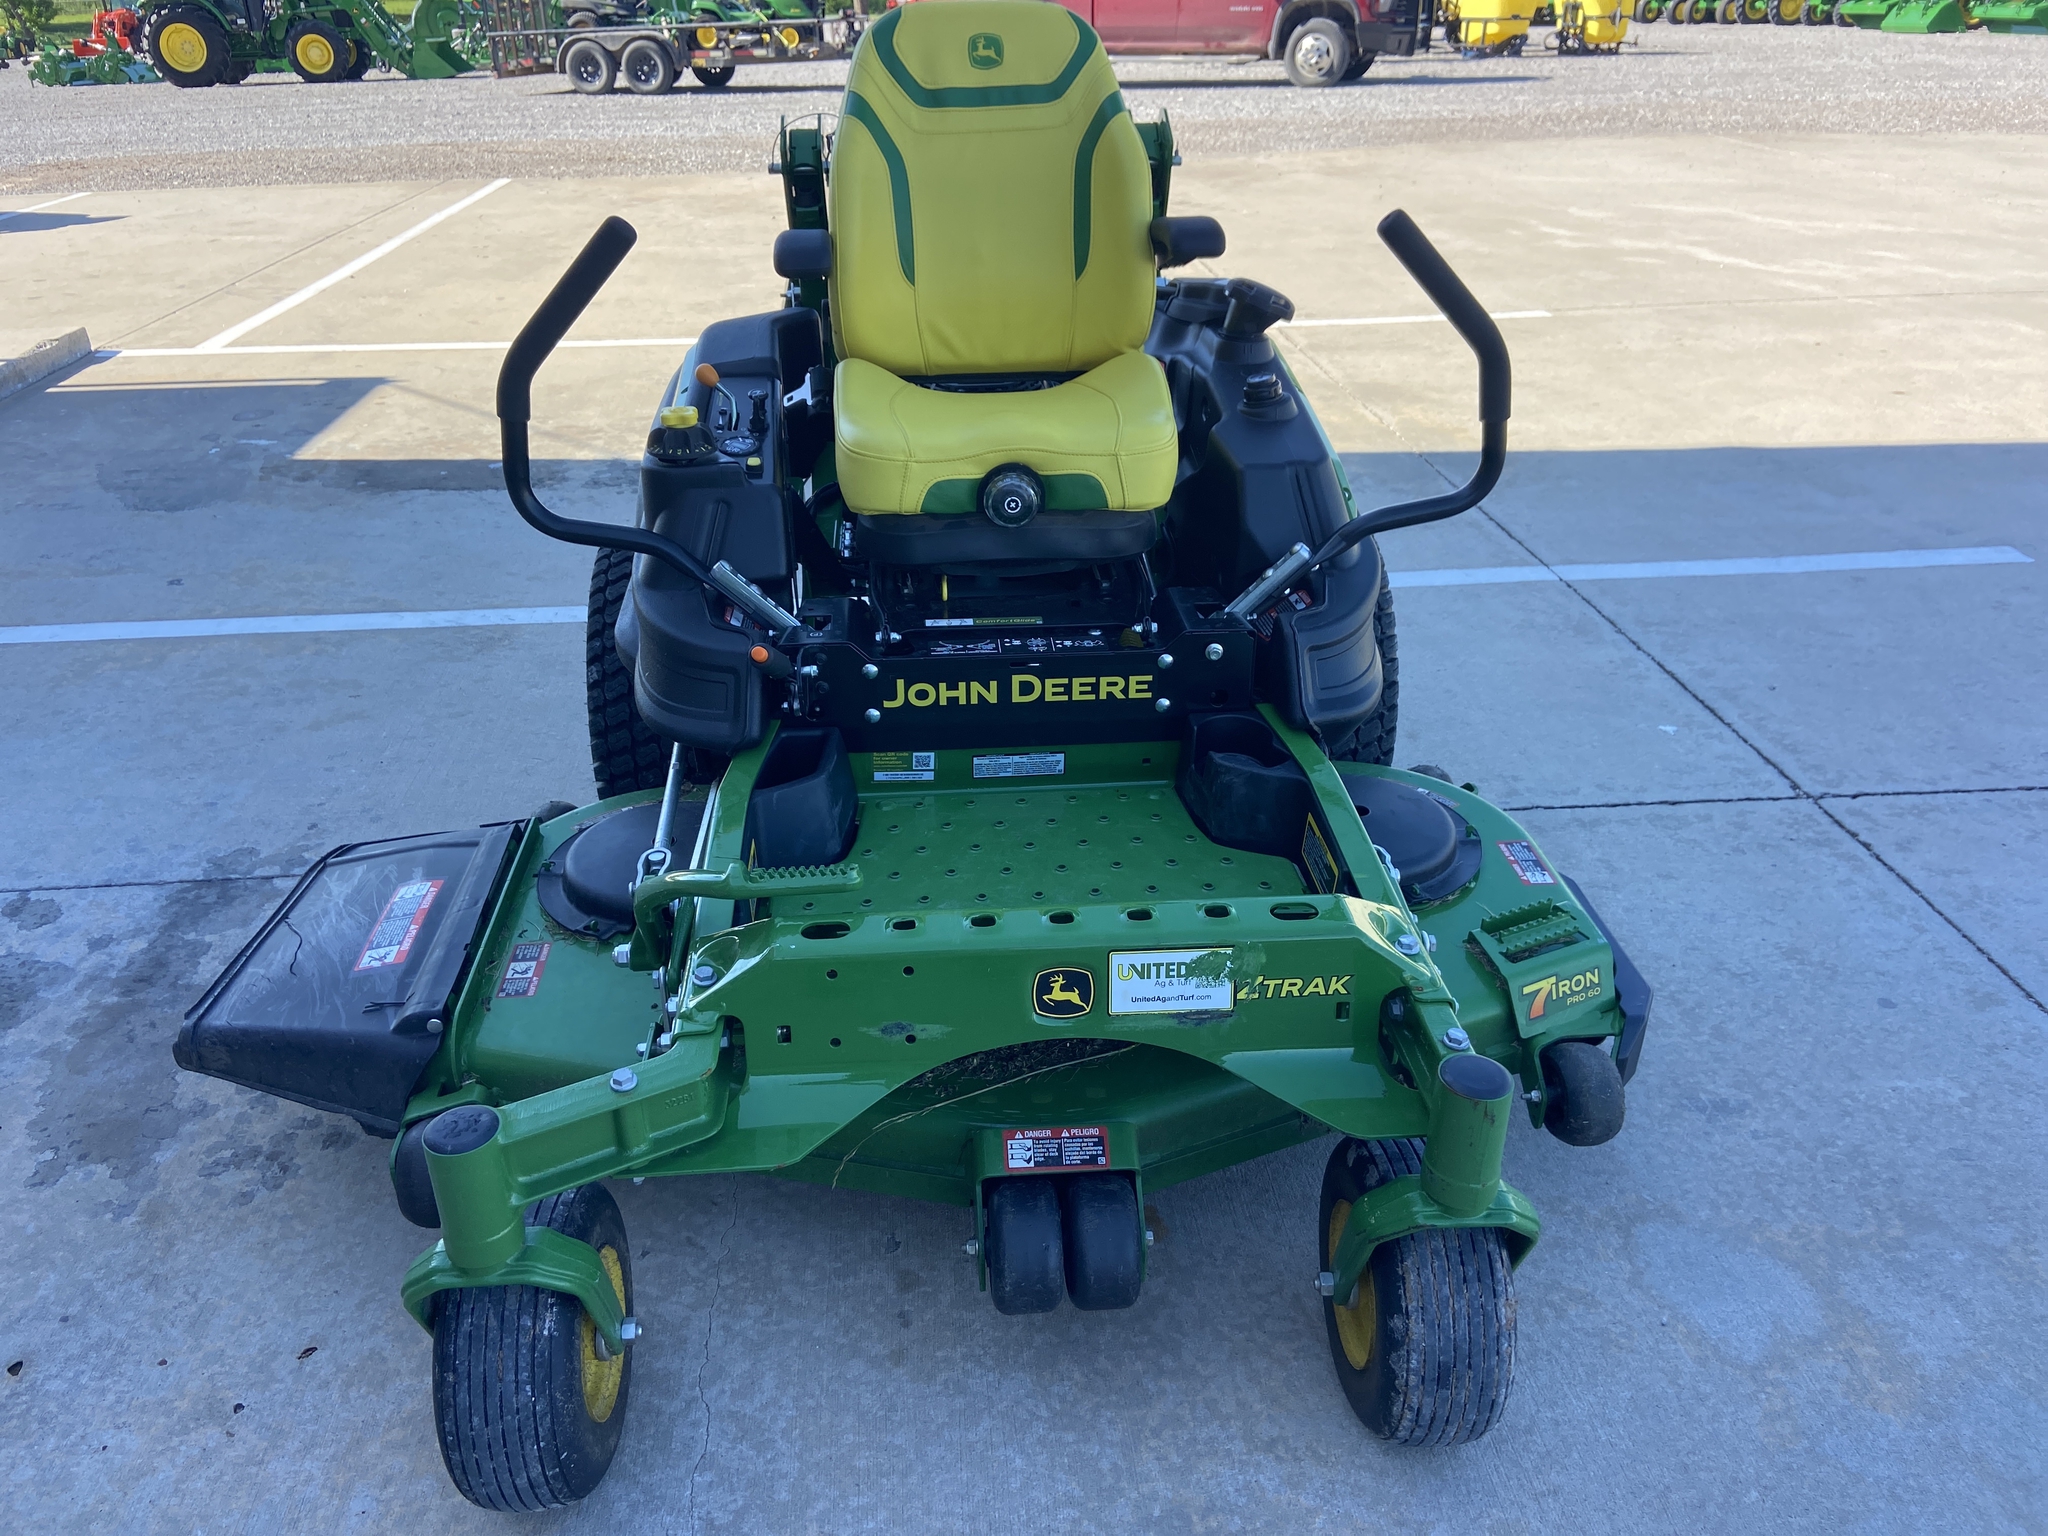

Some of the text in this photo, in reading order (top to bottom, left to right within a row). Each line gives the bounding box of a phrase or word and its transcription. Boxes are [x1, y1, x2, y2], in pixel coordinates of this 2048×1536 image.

[883, 674, 1153, 708] JOHN DEERE
[1117, 961, 1187, 981] UNITED
[1154, 979, 1166, 988] Ag
[1131, 994, 1212, 1003] UnitedAgandTurf.com
[1567, 987, 1600, 1006] PRO 60
[1024, 1130, 1052, 1138] DANGER
[1070, 1127, 1100, 1136] PELIGRO
